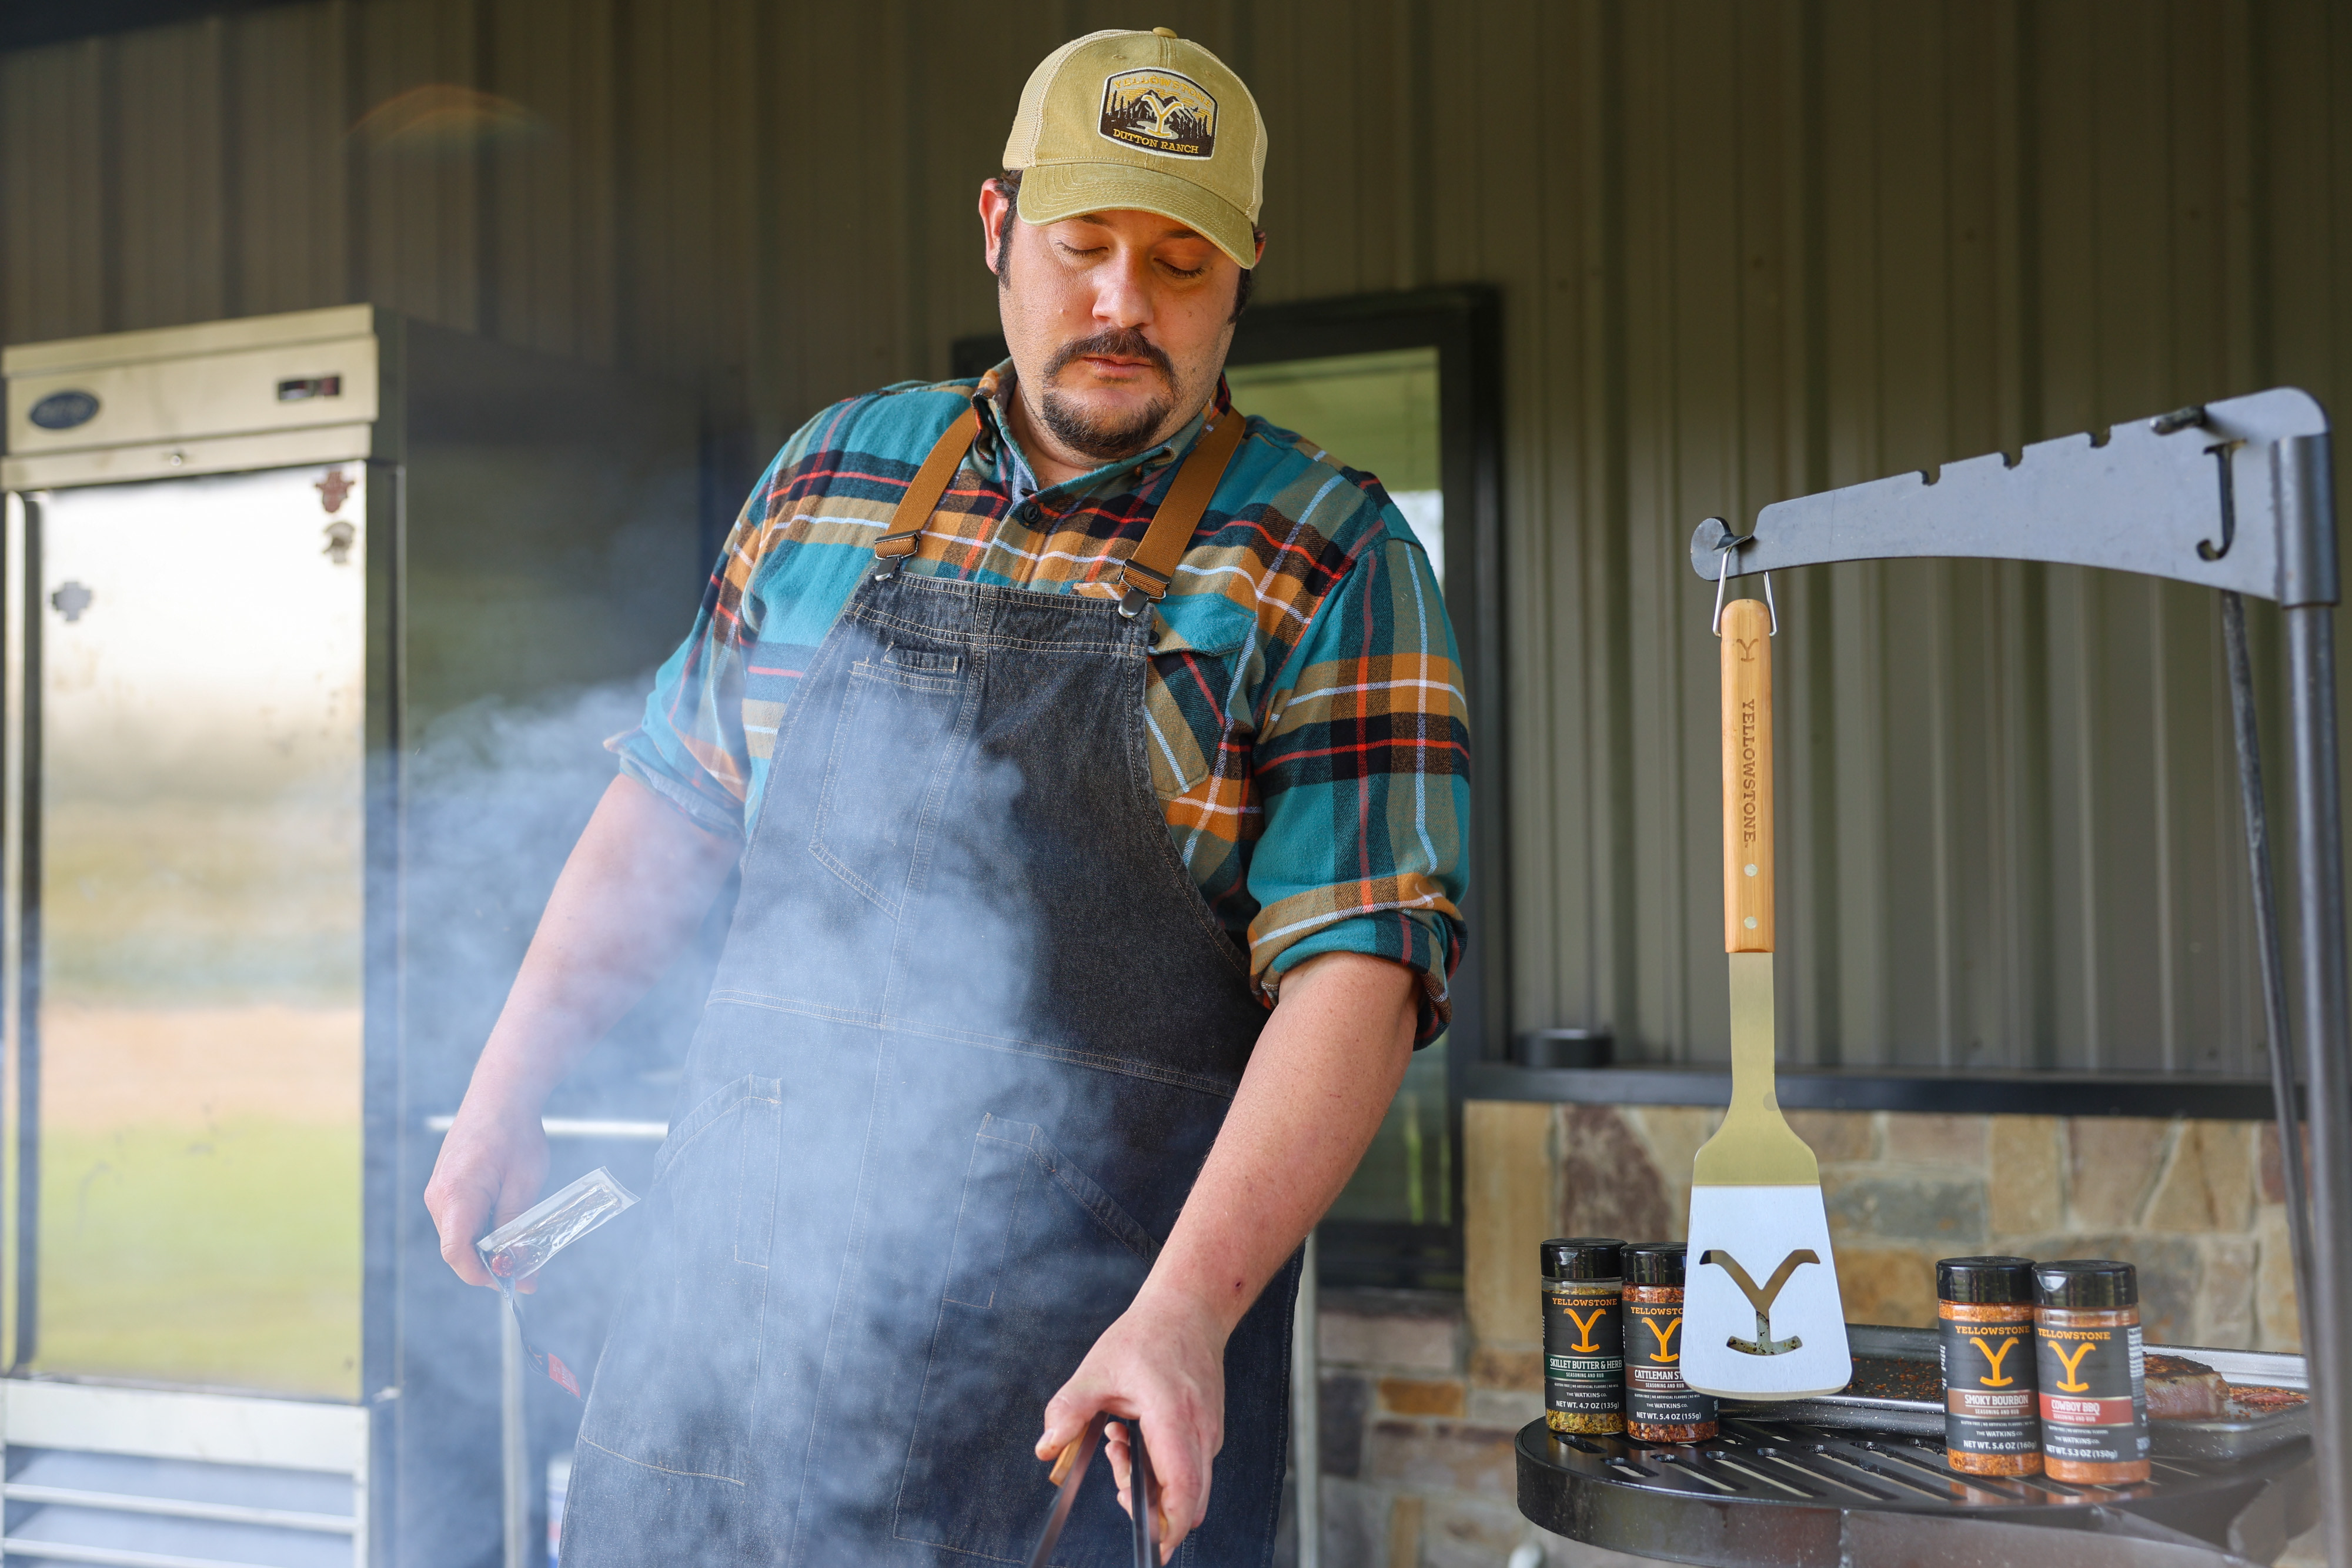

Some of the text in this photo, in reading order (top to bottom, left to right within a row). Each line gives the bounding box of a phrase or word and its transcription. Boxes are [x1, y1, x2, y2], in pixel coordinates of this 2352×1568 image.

[1113, 75, 1212, 108] YELLOWSTONE
[1113, 128, 1199, 154] DUTTON RANCH
[1742, 698, 1756, 842] YELLOWSTONE
[1552, 1298, 1617, 1306] YELLOWSTONE
[1631, 1306, 1683, 1315] YELLOWSTO
[1955, 1325, 2030, 1335] YELLOWSTONE
[2037, 1328, 2111, 1340] YELLOWSTONE
[1550, 1358, 1622, 1369] SKILLET BUTTER & HERB
[1634, 1369, 1673, 1380] CATTLEMAN
[1965, 1394, 2029, 1405] SMOKY BOURBON
[2051, 1399, 2100, 1416] COWBOY BBQ
[1682, 1412, 1701, 1420] (155g)
[1963, 1440, 1976, 1448] NET
[1977, 1442, 1991, 1450] WT.
[2017, 1440, 2037, 1450] (160g)
[2062, 1436, 2092, 1445] WATKINS
[2046, 1444, 2055, 1453] NET
[2055, 1446, 2067, 1455] WT.
[2067, 1448, 2079, 1456] 5.3
